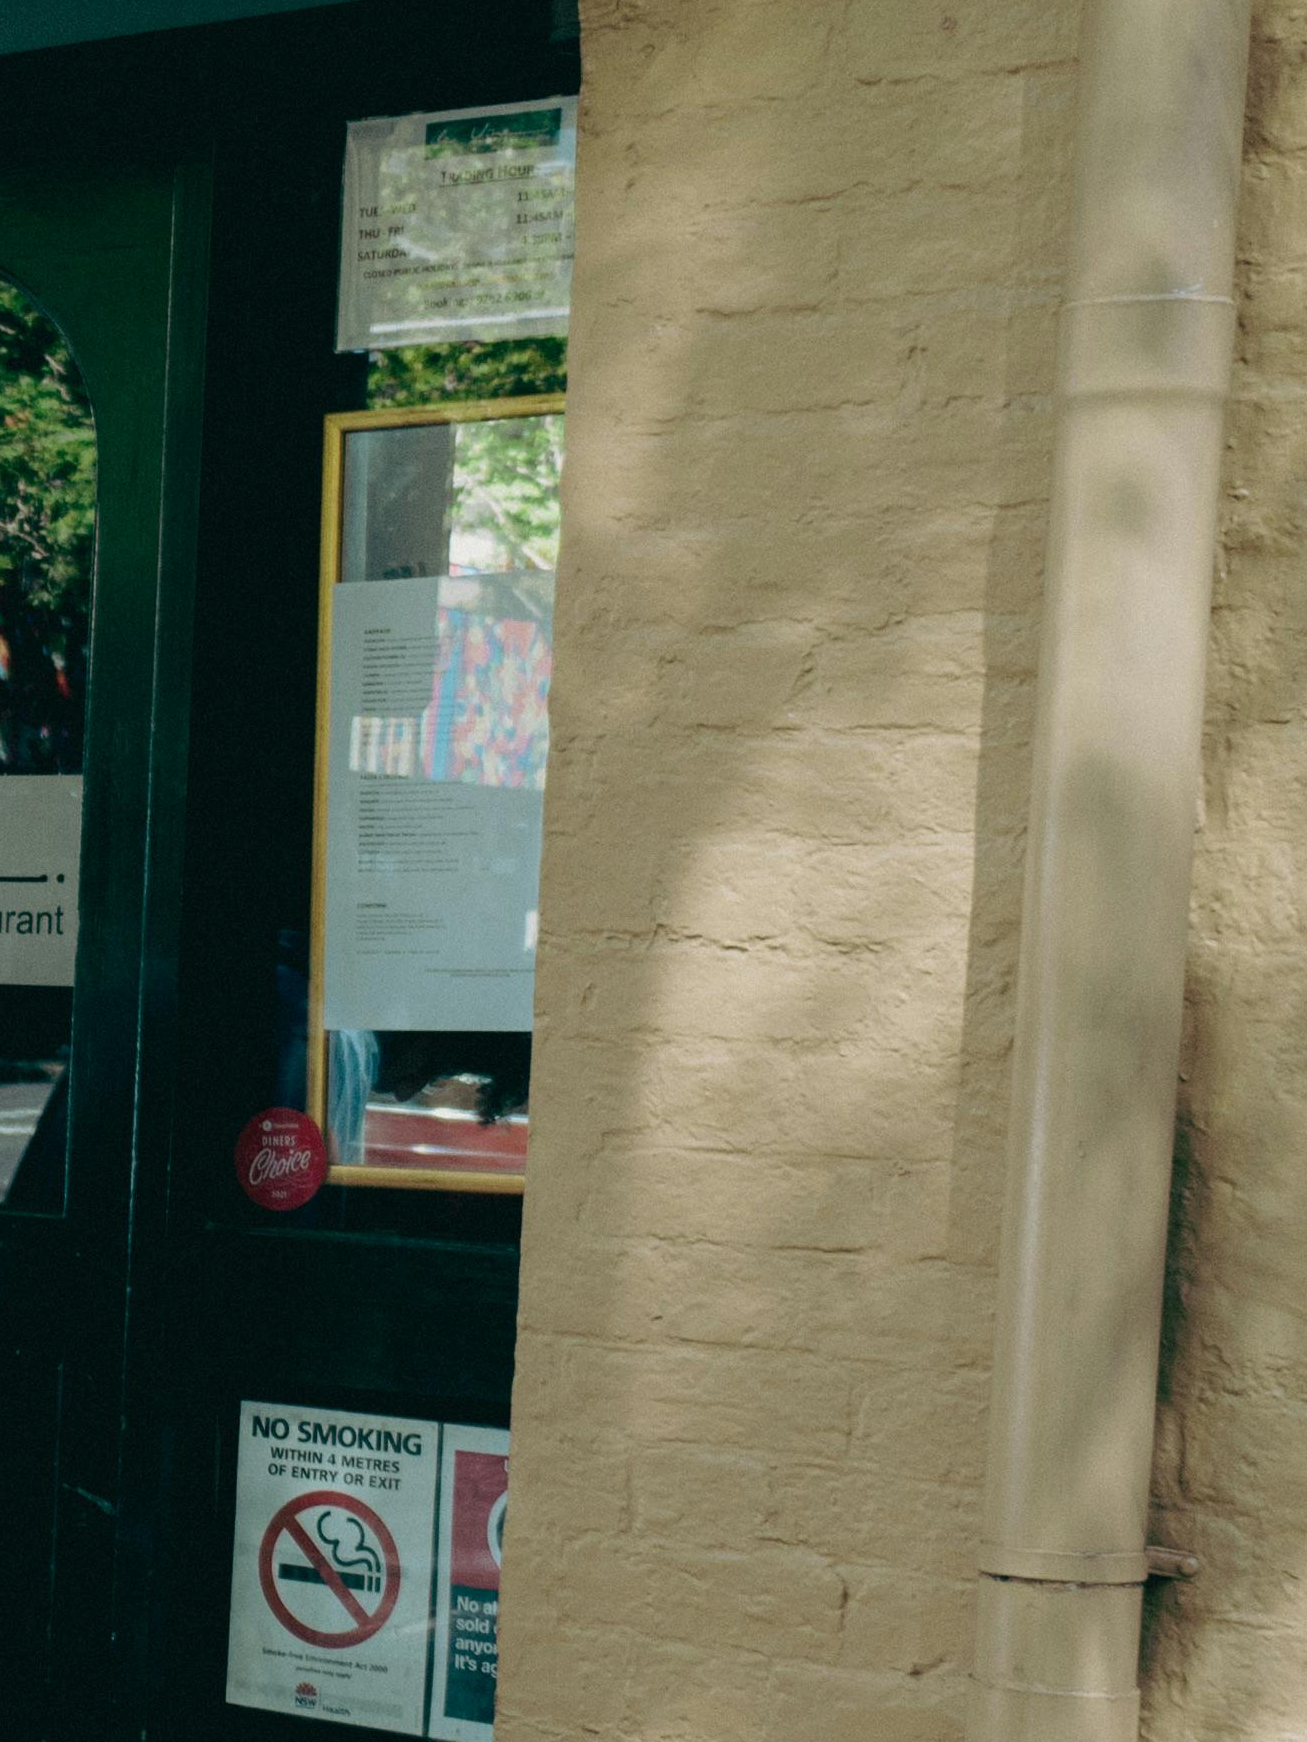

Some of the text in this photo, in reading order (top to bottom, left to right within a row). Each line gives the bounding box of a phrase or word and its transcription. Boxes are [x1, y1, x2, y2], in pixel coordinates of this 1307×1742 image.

[358, 228, 381, 240] THU
[357, 248, 408, 262] SATURDA
[249, 1147, 312, 1186] Choice
[251, 1415, 423, 1456] NO SMOKING
[270, 1446, 401, 1474] WITHIN 4 METRES
[267, 1463, 402, 1491] OF ENTRY OR EXIT
[456, 1595, 479, 1613] No
[456, 1618, 490, 1634] sold
[454, 1653, 477, 1672] It's
[295, 1696, 317, 1707] NSW
